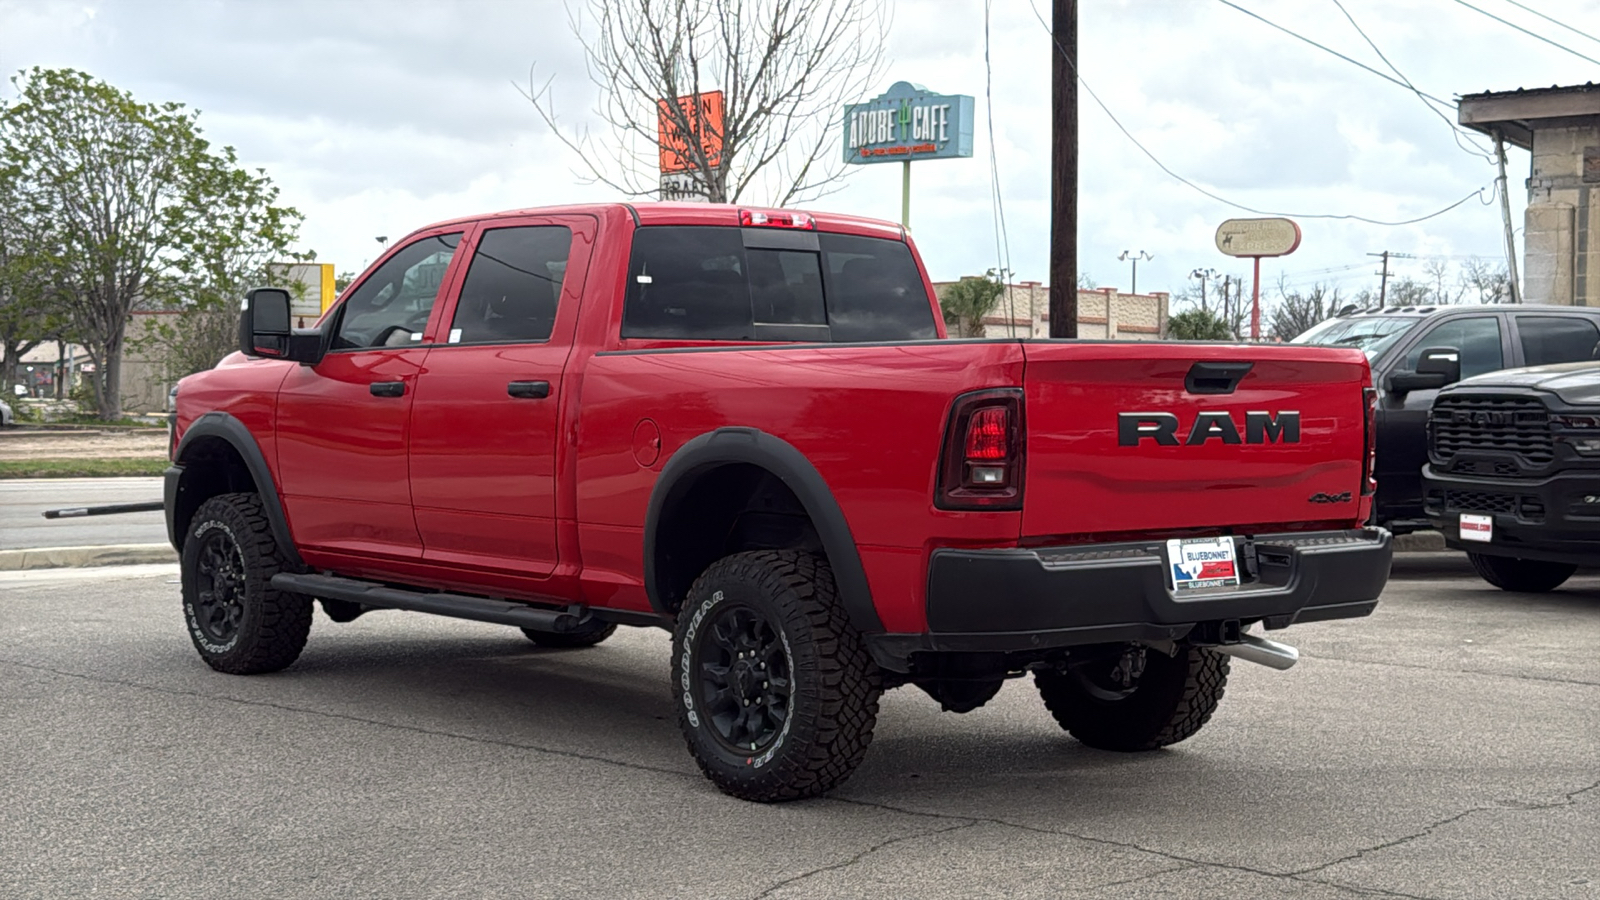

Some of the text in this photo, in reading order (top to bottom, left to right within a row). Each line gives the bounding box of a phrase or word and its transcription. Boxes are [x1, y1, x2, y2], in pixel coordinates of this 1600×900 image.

[849, 104, 950, 148] ADOBE CAFE
[1118, 410, 1300, 446] RAM
[1186, 551, 1229, 561] BLUEBONNET
[1187, 580, 1225, 588] BLUEBONNET
[682, 590, 724, 727] GOODYEAR
